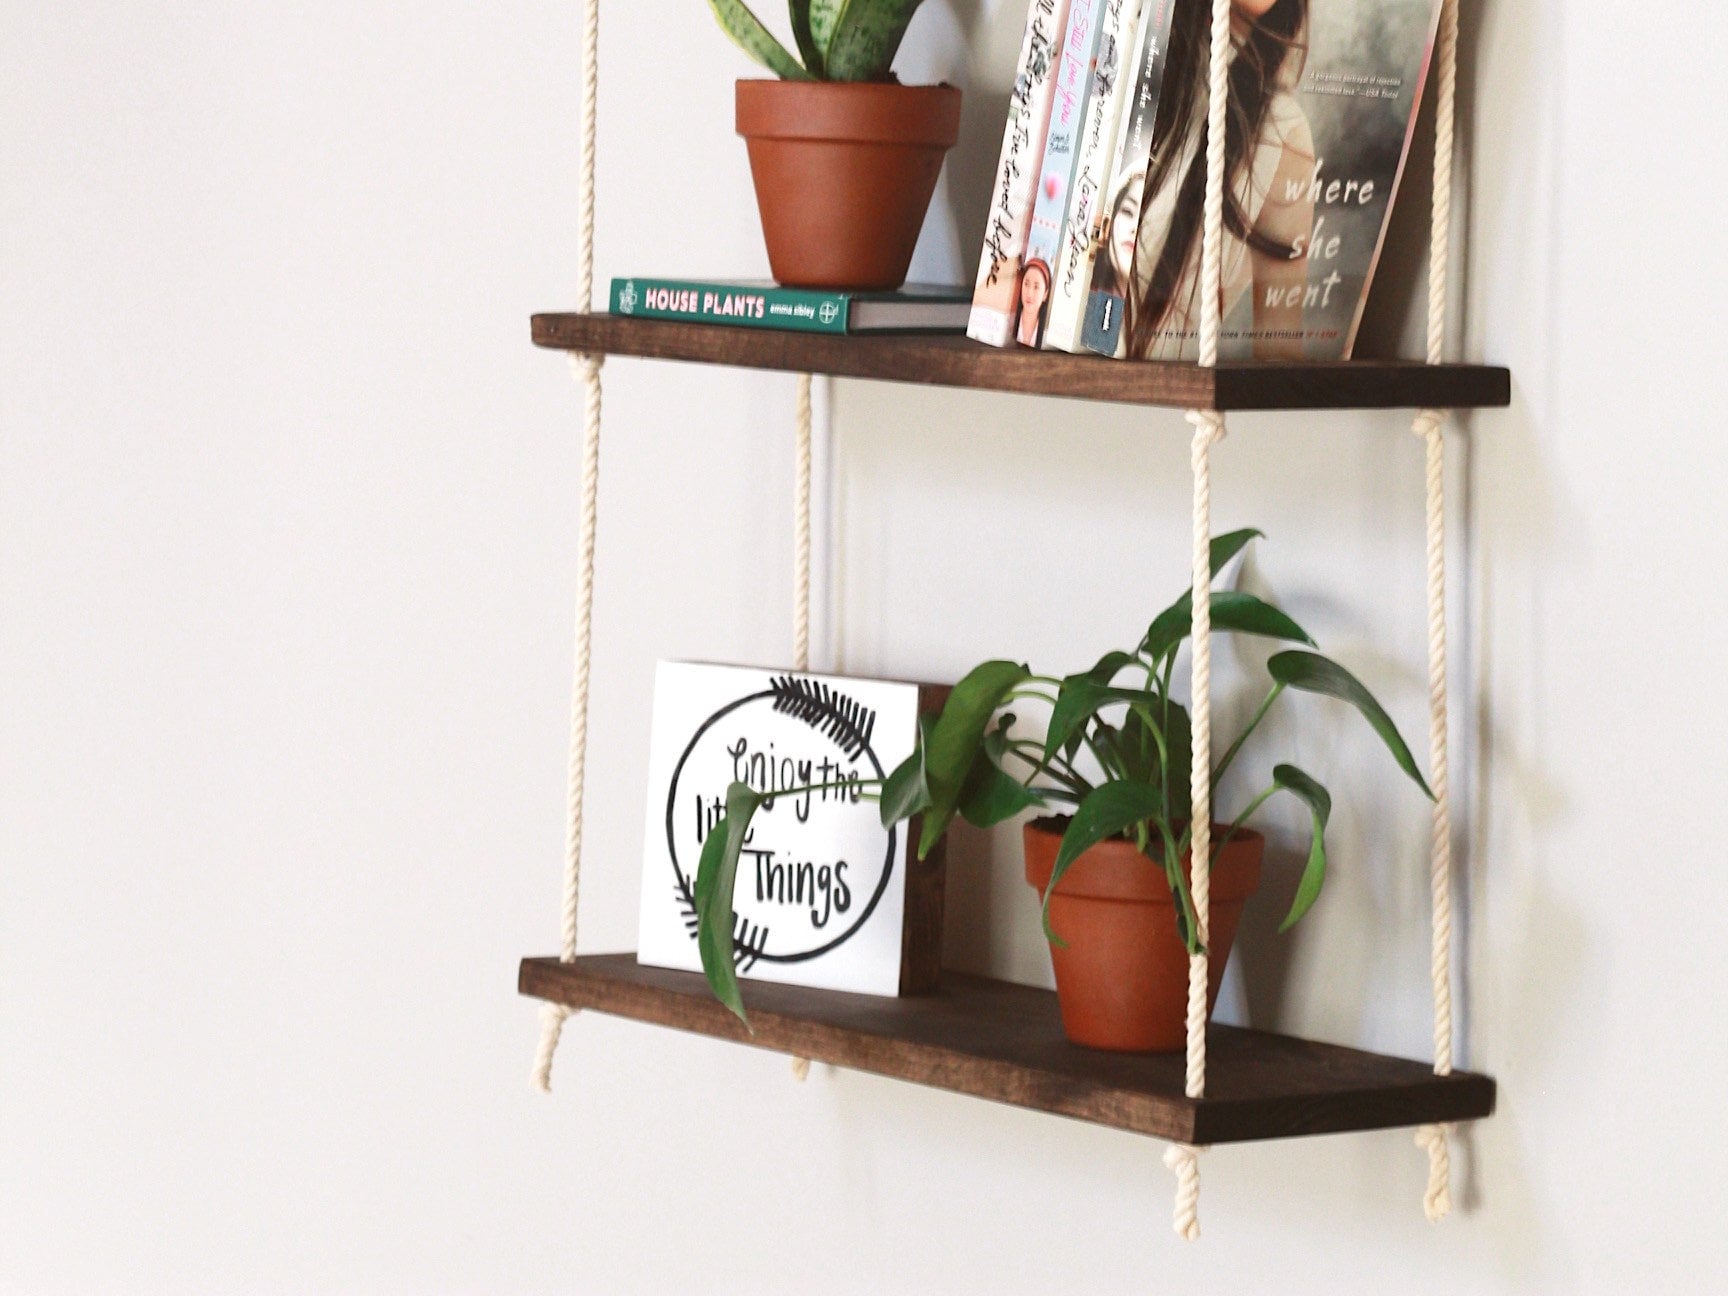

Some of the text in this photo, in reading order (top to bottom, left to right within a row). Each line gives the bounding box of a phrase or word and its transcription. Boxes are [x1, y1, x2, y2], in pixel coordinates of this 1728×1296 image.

[1132, 36, 1160, 150] where she went
[999, 156, 1021, 220] loved
[1285, 157, 1374, 204] where
[985, 218, 1012, 288] before
[1289, 215, 1341, 260] she
[645, 287, 765, 319] HOUSE PLANTS
[1265, 270, 1342, 308] went
[816, 756, 862, 804] the
[741, 849, 851, 928] Things
